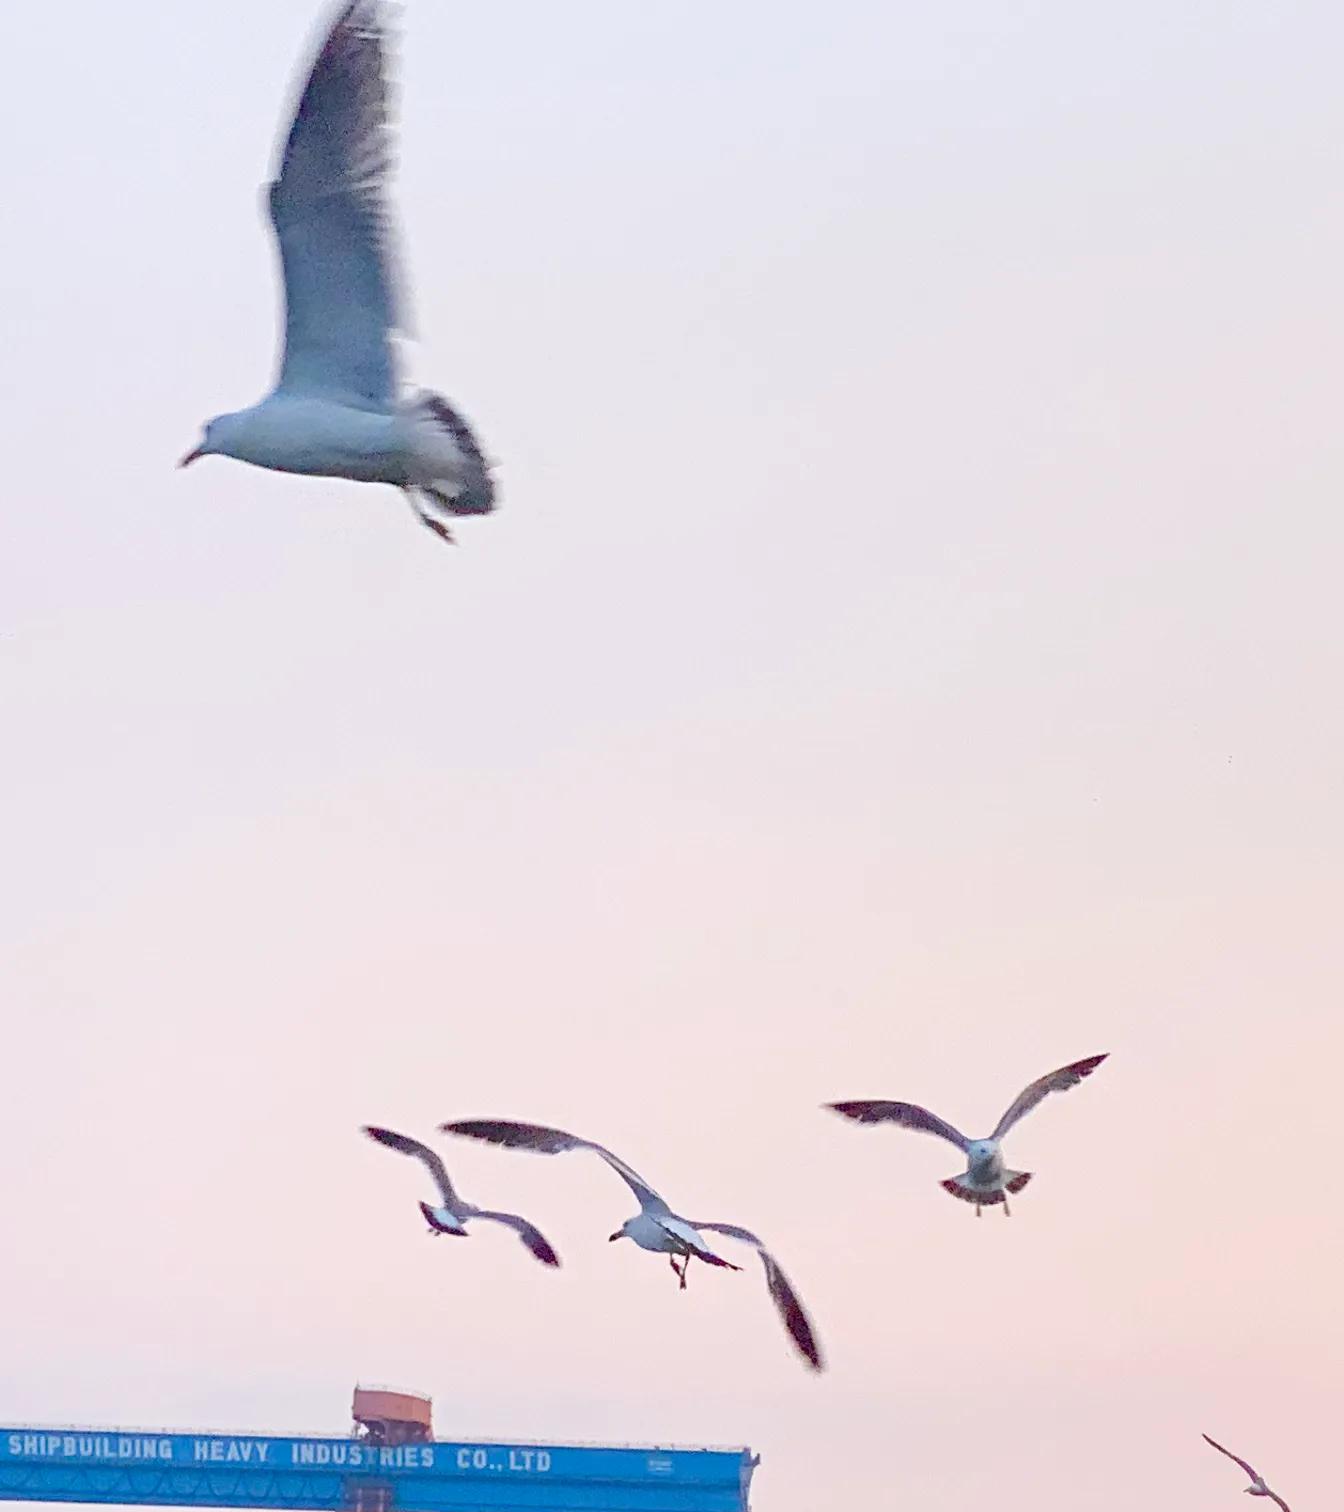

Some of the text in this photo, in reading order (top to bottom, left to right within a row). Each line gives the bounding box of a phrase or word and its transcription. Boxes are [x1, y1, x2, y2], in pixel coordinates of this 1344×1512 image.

[8, 1434, 173, 1460] SHIPBUILDING
[194, 1440, 269, 1463] HEAVY
[291, 1443, 434, 1468] INDUSTRIES
